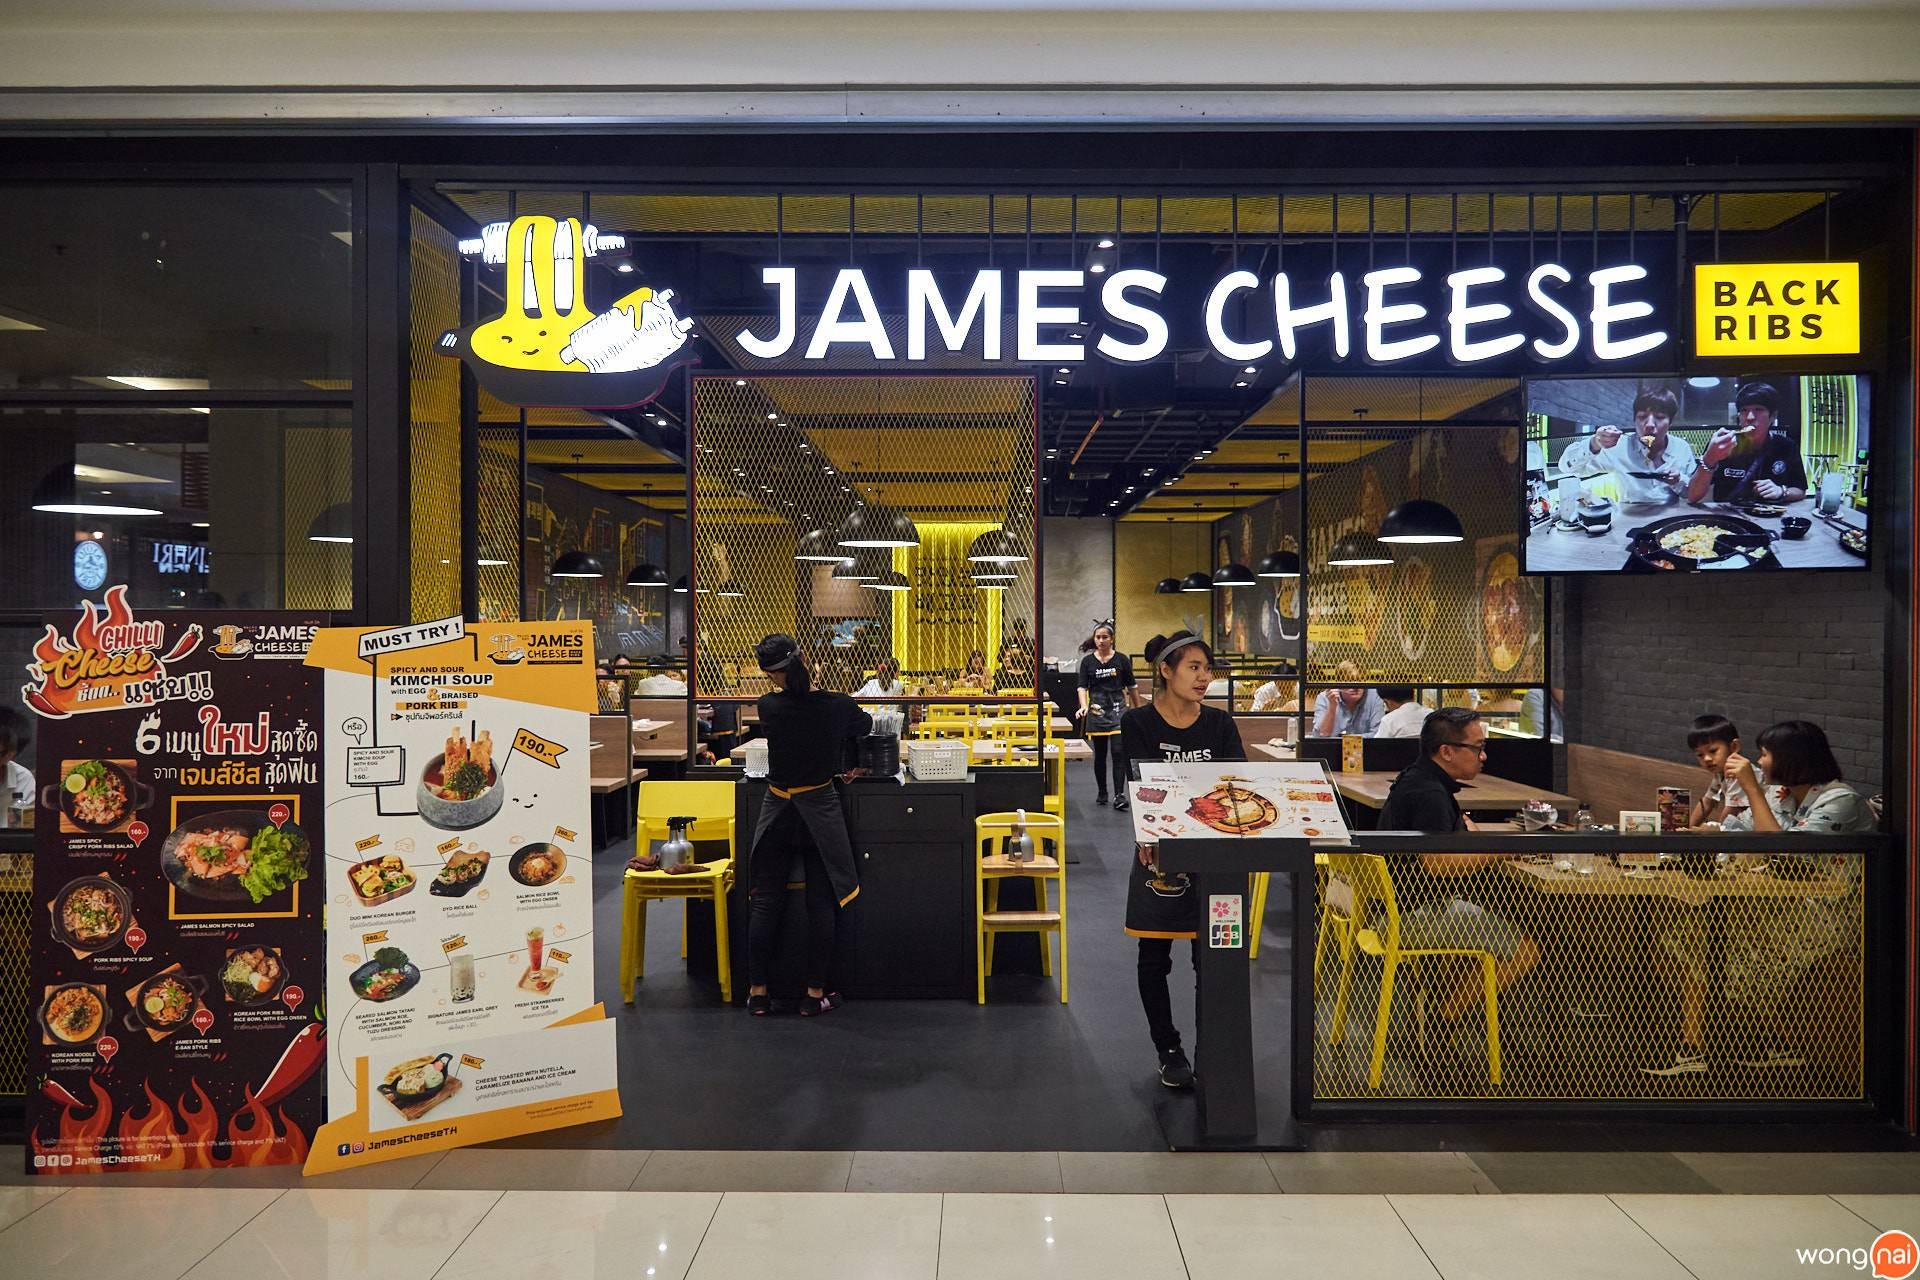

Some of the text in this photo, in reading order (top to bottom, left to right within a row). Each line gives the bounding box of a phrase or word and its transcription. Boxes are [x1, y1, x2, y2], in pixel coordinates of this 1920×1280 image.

[1713, 279, 1841, 307] BACK
[735, 264, 1668, 363] JAMES CHEESE
[1713, 314, 1824, 341] RIBS
[101, 622, 162, 651] CHILLI
[254, 625, 319, 641] JAMES
[364, 631, 412, 651] MUST
[417, 624, 450, 640] TRY
[527, 634, 583, 647] JAMES
[254, 642, 301, 653] CHEESE
[527, 649, 567, 658] CHEESE
[42, 649, 155, 688] Cheese
[390, 674, 493, 686] KIMCHI SOUP
[405, 701, 459, 710] PORK RIB
[136, 708, 161, 755] 6
[347, 722, 363, 731] หรือ
[519, 735, 553, 757] 190.-
[1163, 748, 1212, 764] JAMES
[153, 767, 177, 780] จาก
[530, 997, 564, 1006] STRAWBERRIES
[475, 1076, 497, 1085] CHEESE
[499, 1072, 524, 1080] TOASTED
[475, 1081, 510, 1091] CARAMELIZE
[511, 1077, 534, 1085] BANANA
[557, 1069, 576, 1077] CREAM
[368, 1126, 457, 1150] JamesCheeseTH
[74, 1153, 161, 1165] JamesCheeseTH
